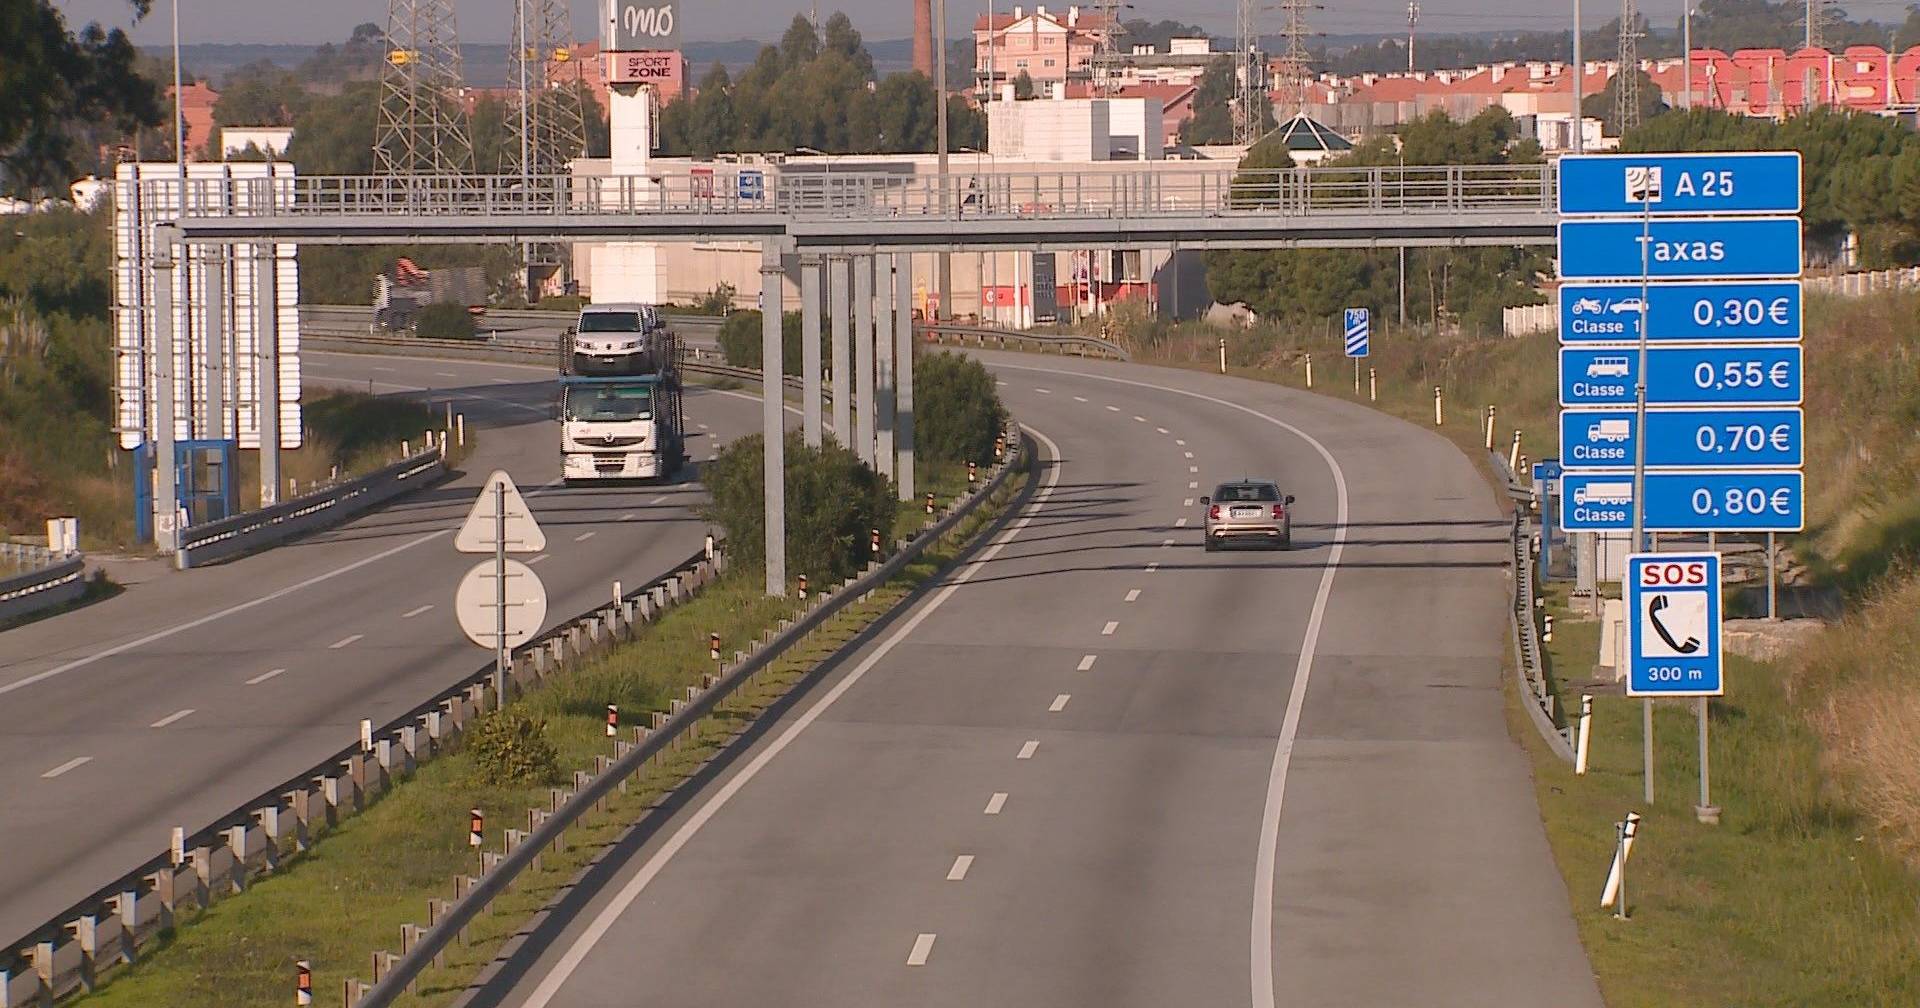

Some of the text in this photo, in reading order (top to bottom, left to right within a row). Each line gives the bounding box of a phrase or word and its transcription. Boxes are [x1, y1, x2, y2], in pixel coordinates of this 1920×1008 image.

[629, 57, 671, 67] SPORT
[629, 67, 671, 77] ZONE
[1635, 236, 1725, 261] Taxas
[1572, 319, 1624, 333] Classe
[1573, 382, 1625, 396] Classe
[1573, 445, 1625, 459] Classe
[1574, 507, 1626, 521] Classe
[1643, 564, 1703, 585] SOS
[1648, 667, 1703, 681] 300 m
